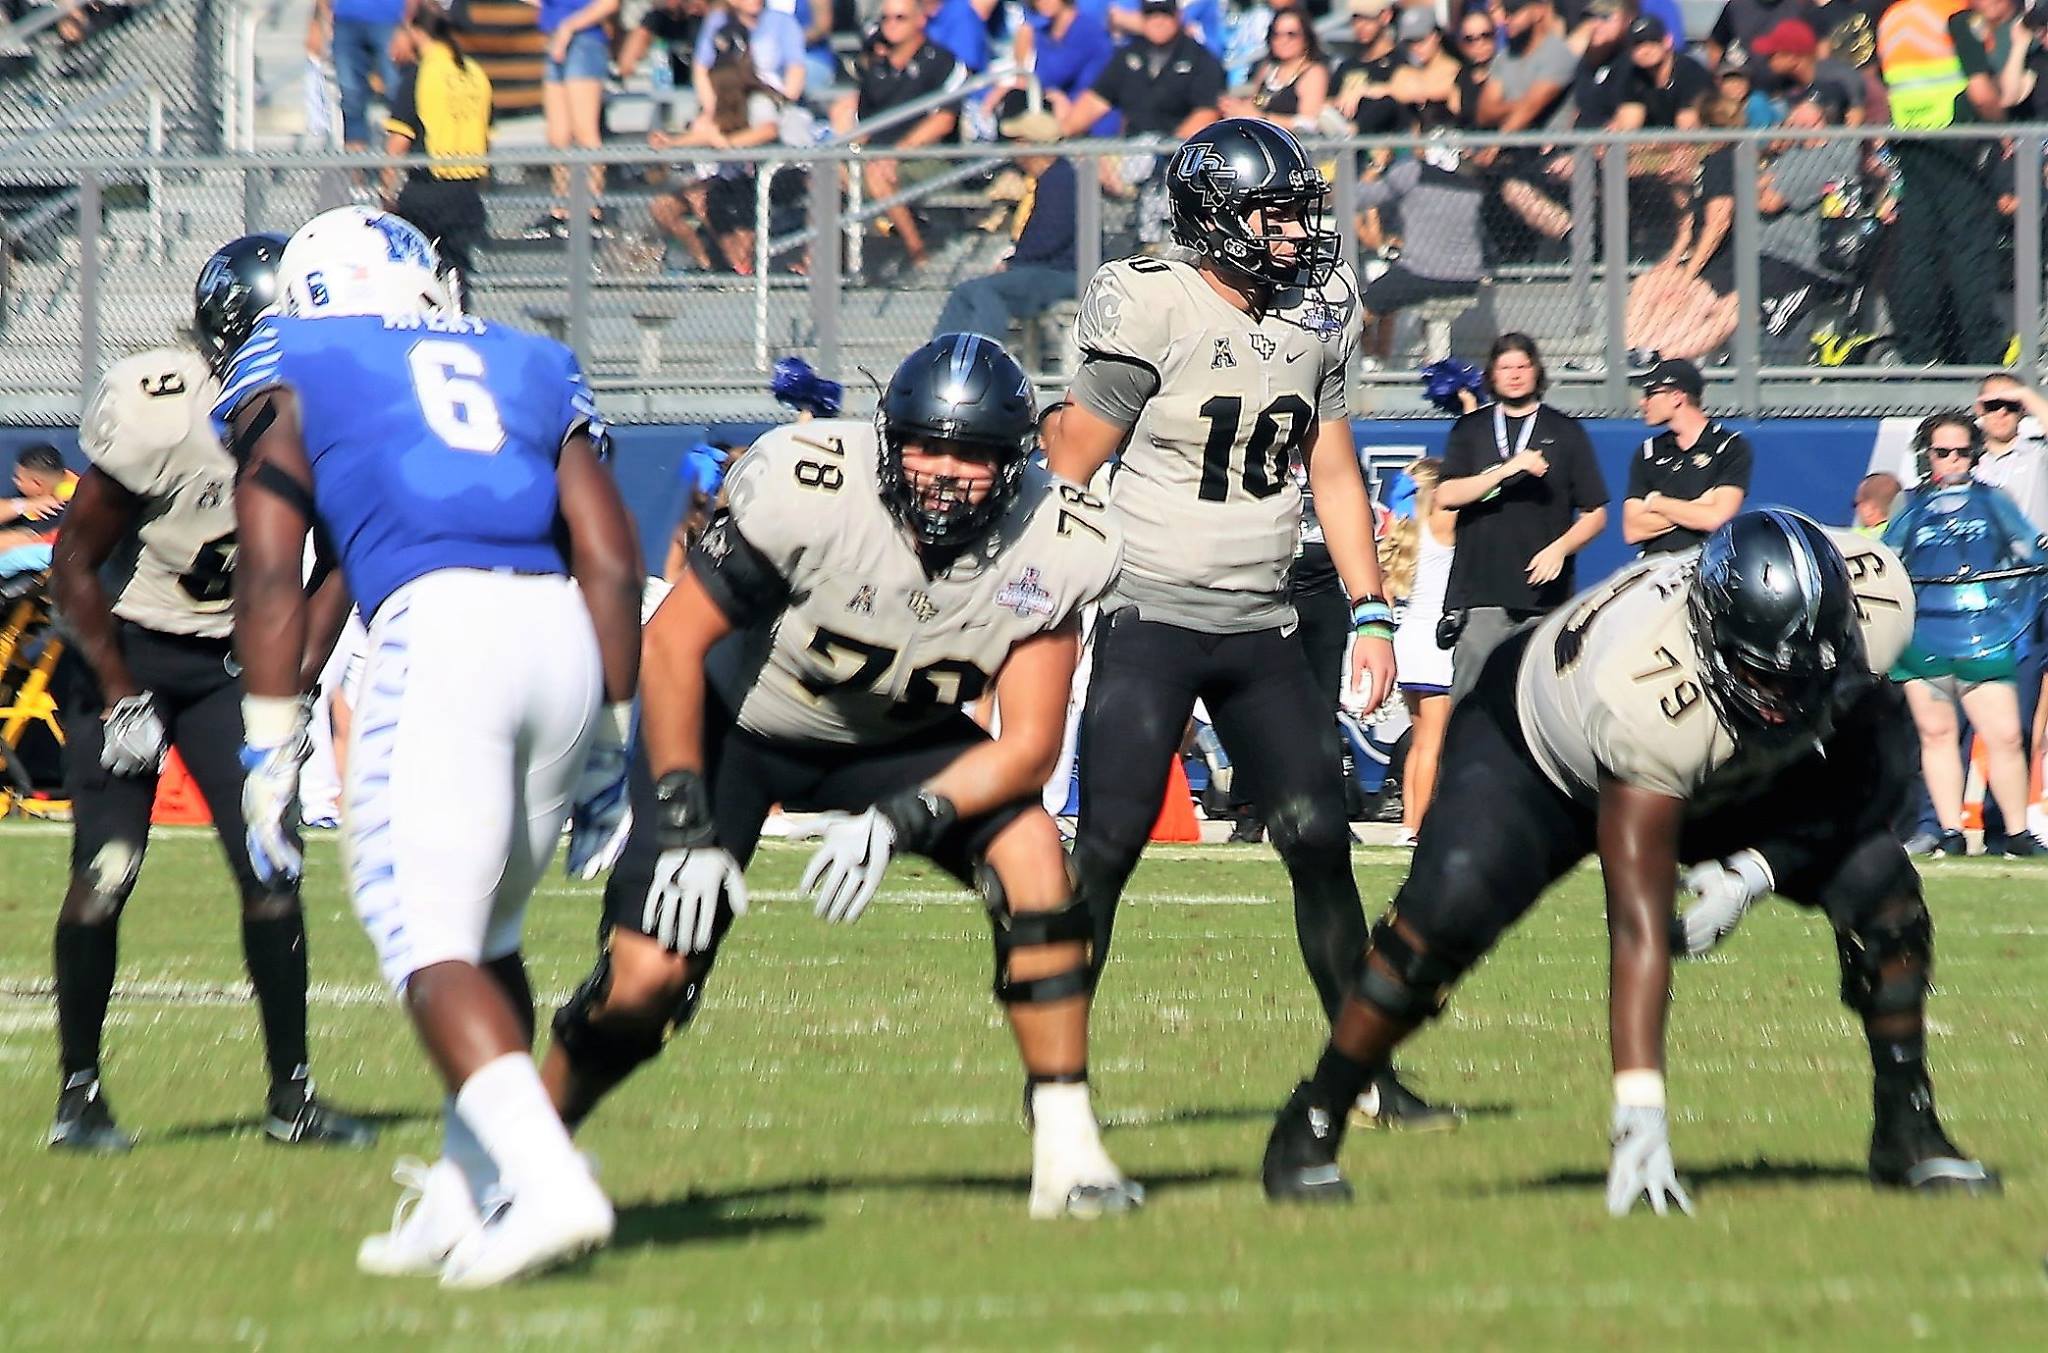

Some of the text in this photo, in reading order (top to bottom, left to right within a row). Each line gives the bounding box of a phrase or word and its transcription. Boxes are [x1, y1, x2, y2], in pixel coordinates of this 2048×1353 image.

[407, 338, 507, 455] 6
[791, 432, 846, 492] 78
[1198, 394, 1314, 502] 10
[1056, 484, 1107, 545] 78
[1846, 550, 1904, 627] 79
[1632, 645, 1701, 729] 79
